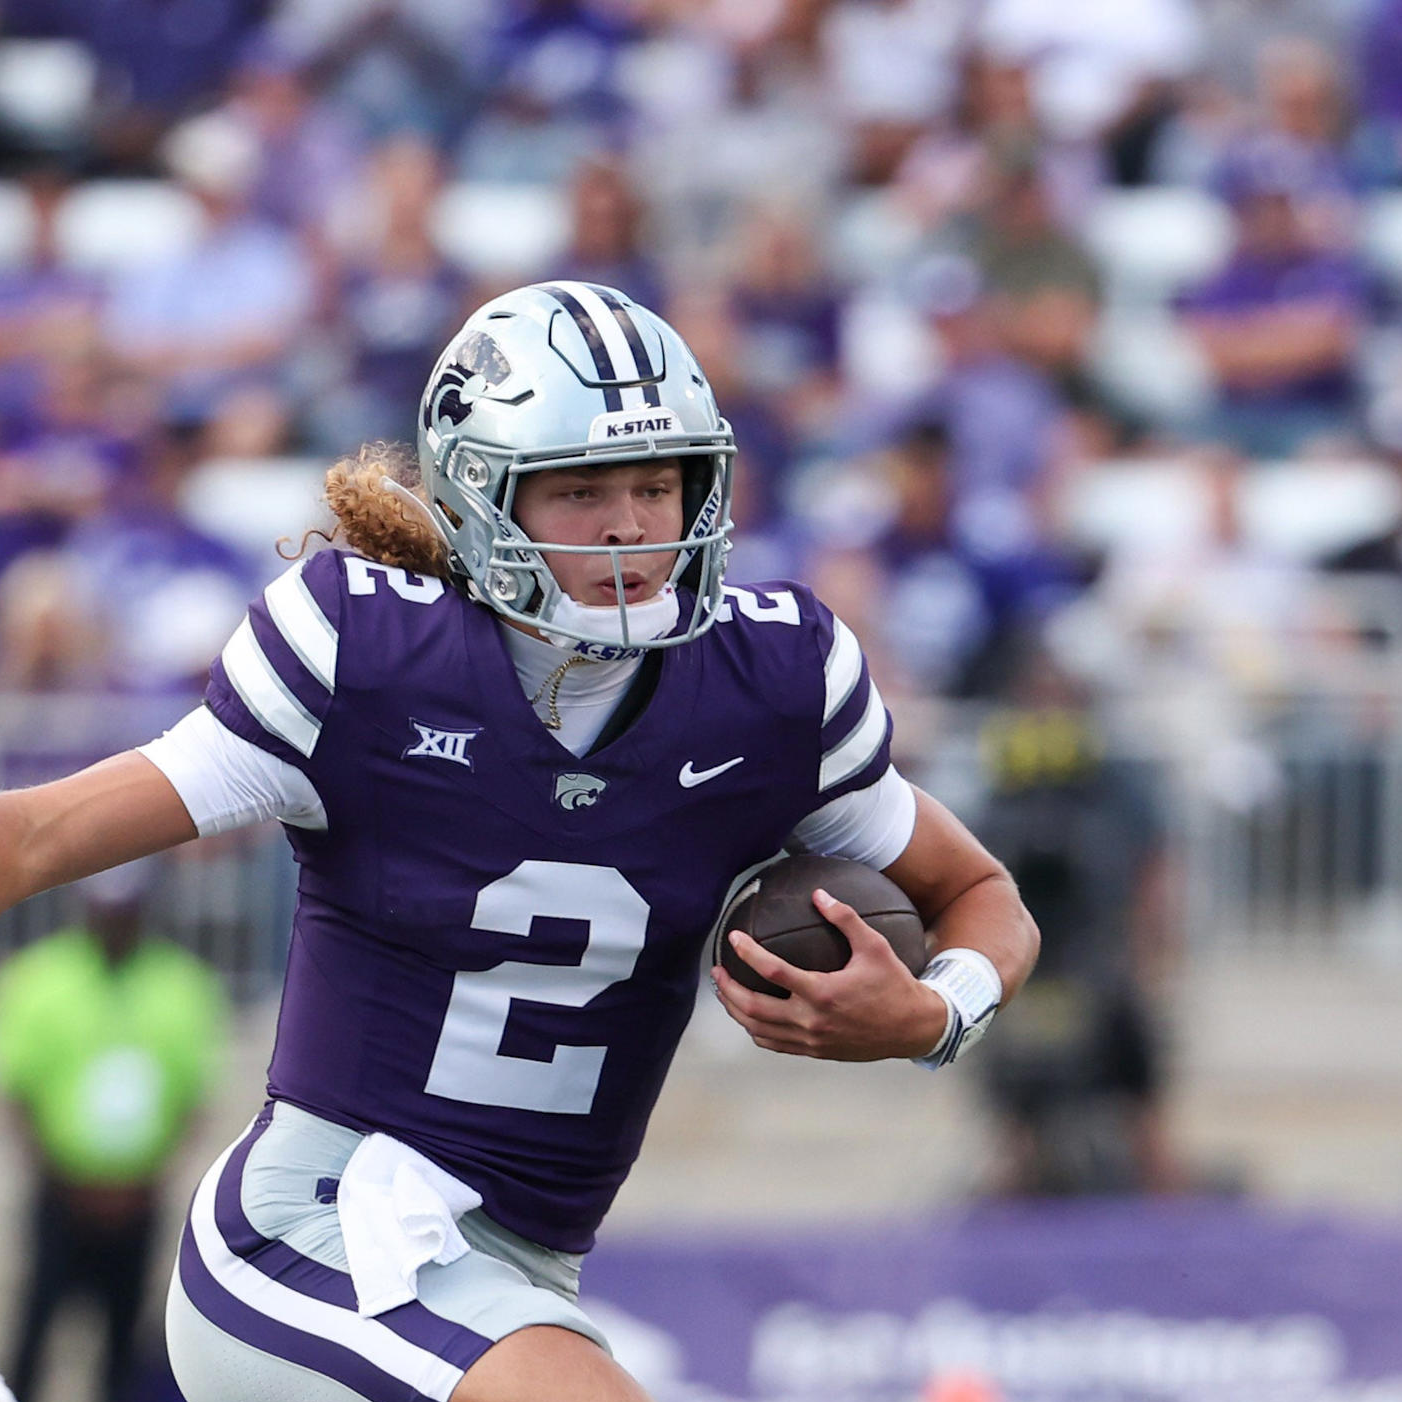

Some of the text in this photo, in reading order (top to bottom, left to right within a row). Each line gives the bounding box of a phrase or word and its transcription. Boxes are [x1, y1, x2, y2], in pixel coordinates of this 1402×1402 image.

[607, 417, 672, 437] K-STATE
[343, 556, 446, 605] 2
[702, 584, 801, 626] 2
[424, 859, 651, 1115] 2
